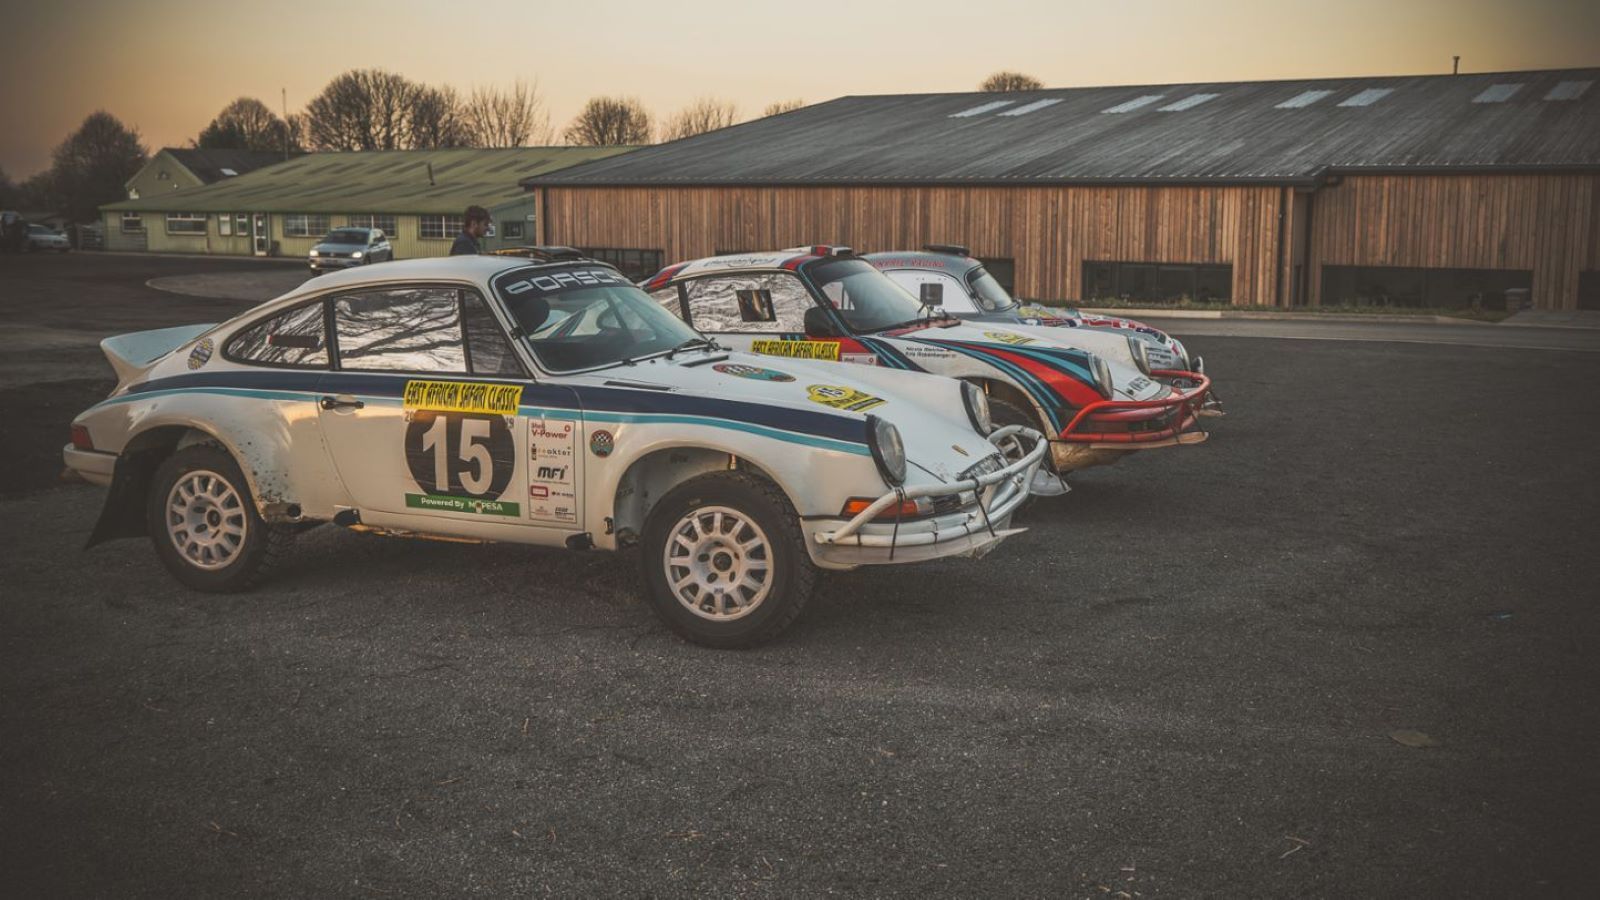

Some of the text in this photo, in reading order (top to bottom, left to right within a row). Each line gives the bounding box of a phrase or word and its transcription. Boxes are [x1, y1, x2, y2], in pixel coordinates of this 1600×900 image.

[406, 382, 519, 412] EAST AFRICAN SAFARI CLASSIC
[531, 429, 568, 439] V-Power
[422, 415, 494, 495] 15
[421, 497, 454, 507] Powered
[454, 501, 465, 509] By
